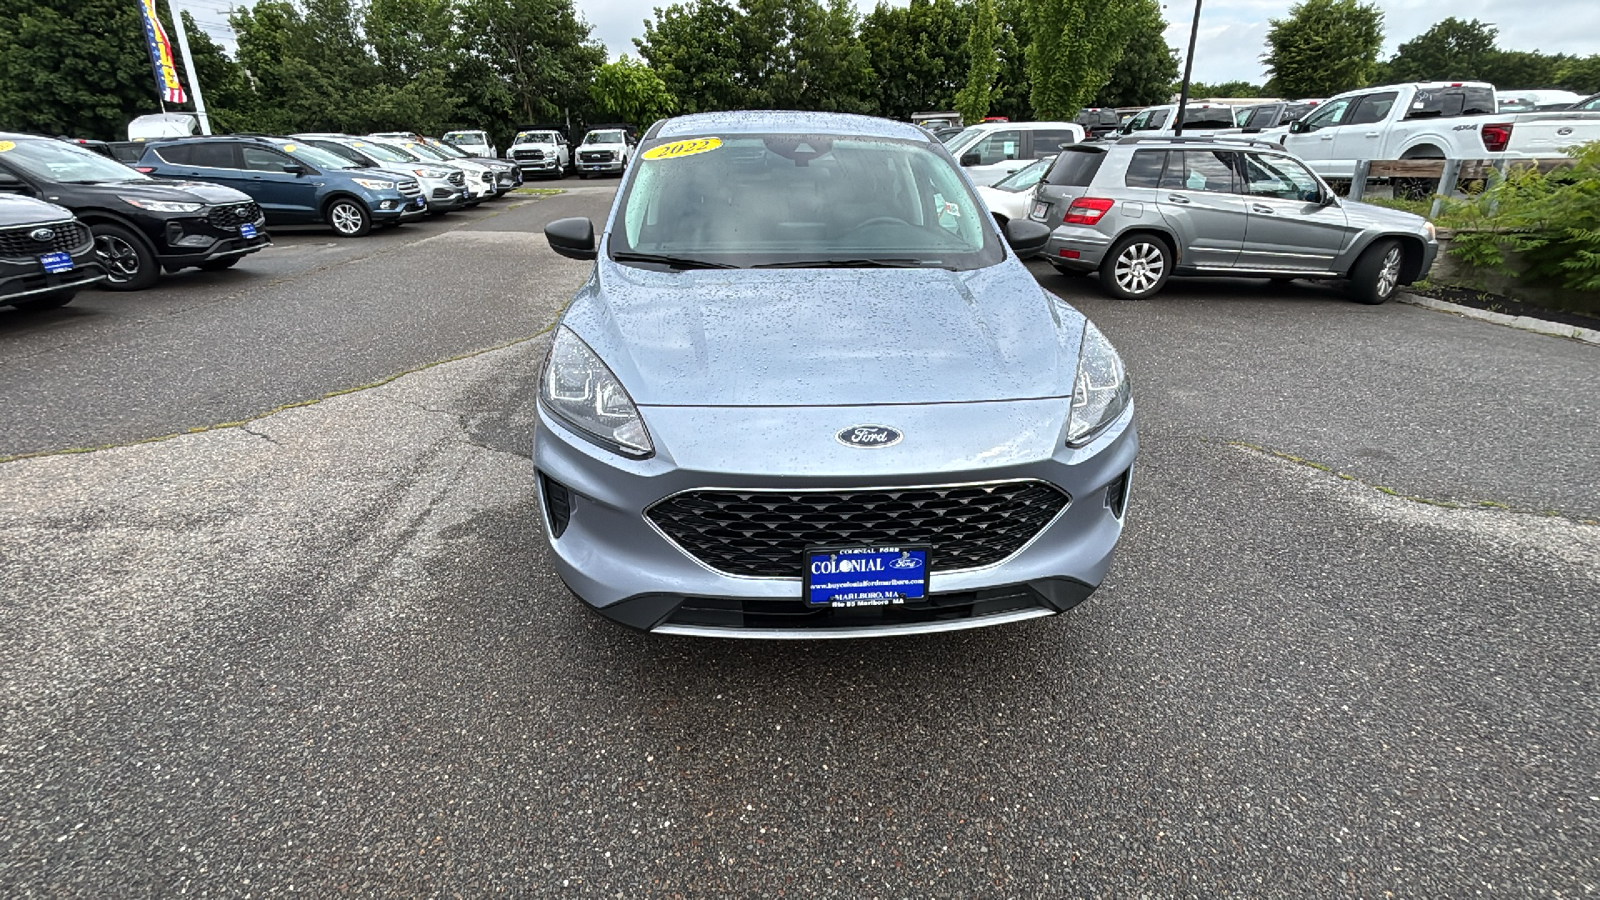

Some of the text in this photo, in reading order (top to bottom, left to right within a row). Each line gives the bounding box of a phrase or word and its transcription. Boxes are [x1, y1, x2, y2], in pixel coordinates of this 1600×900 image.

[657, 141, 709, 157] 2022
[851, 428, 888, 442] Ford
[839, 547, 876, 555] COLONIAL
[811, 558, 885, 575] COLONIAL
[810, 579, 924, 590] www.buycolonialfordmarlboro.com
[834, 591, 884, 600] MARLBORO,
